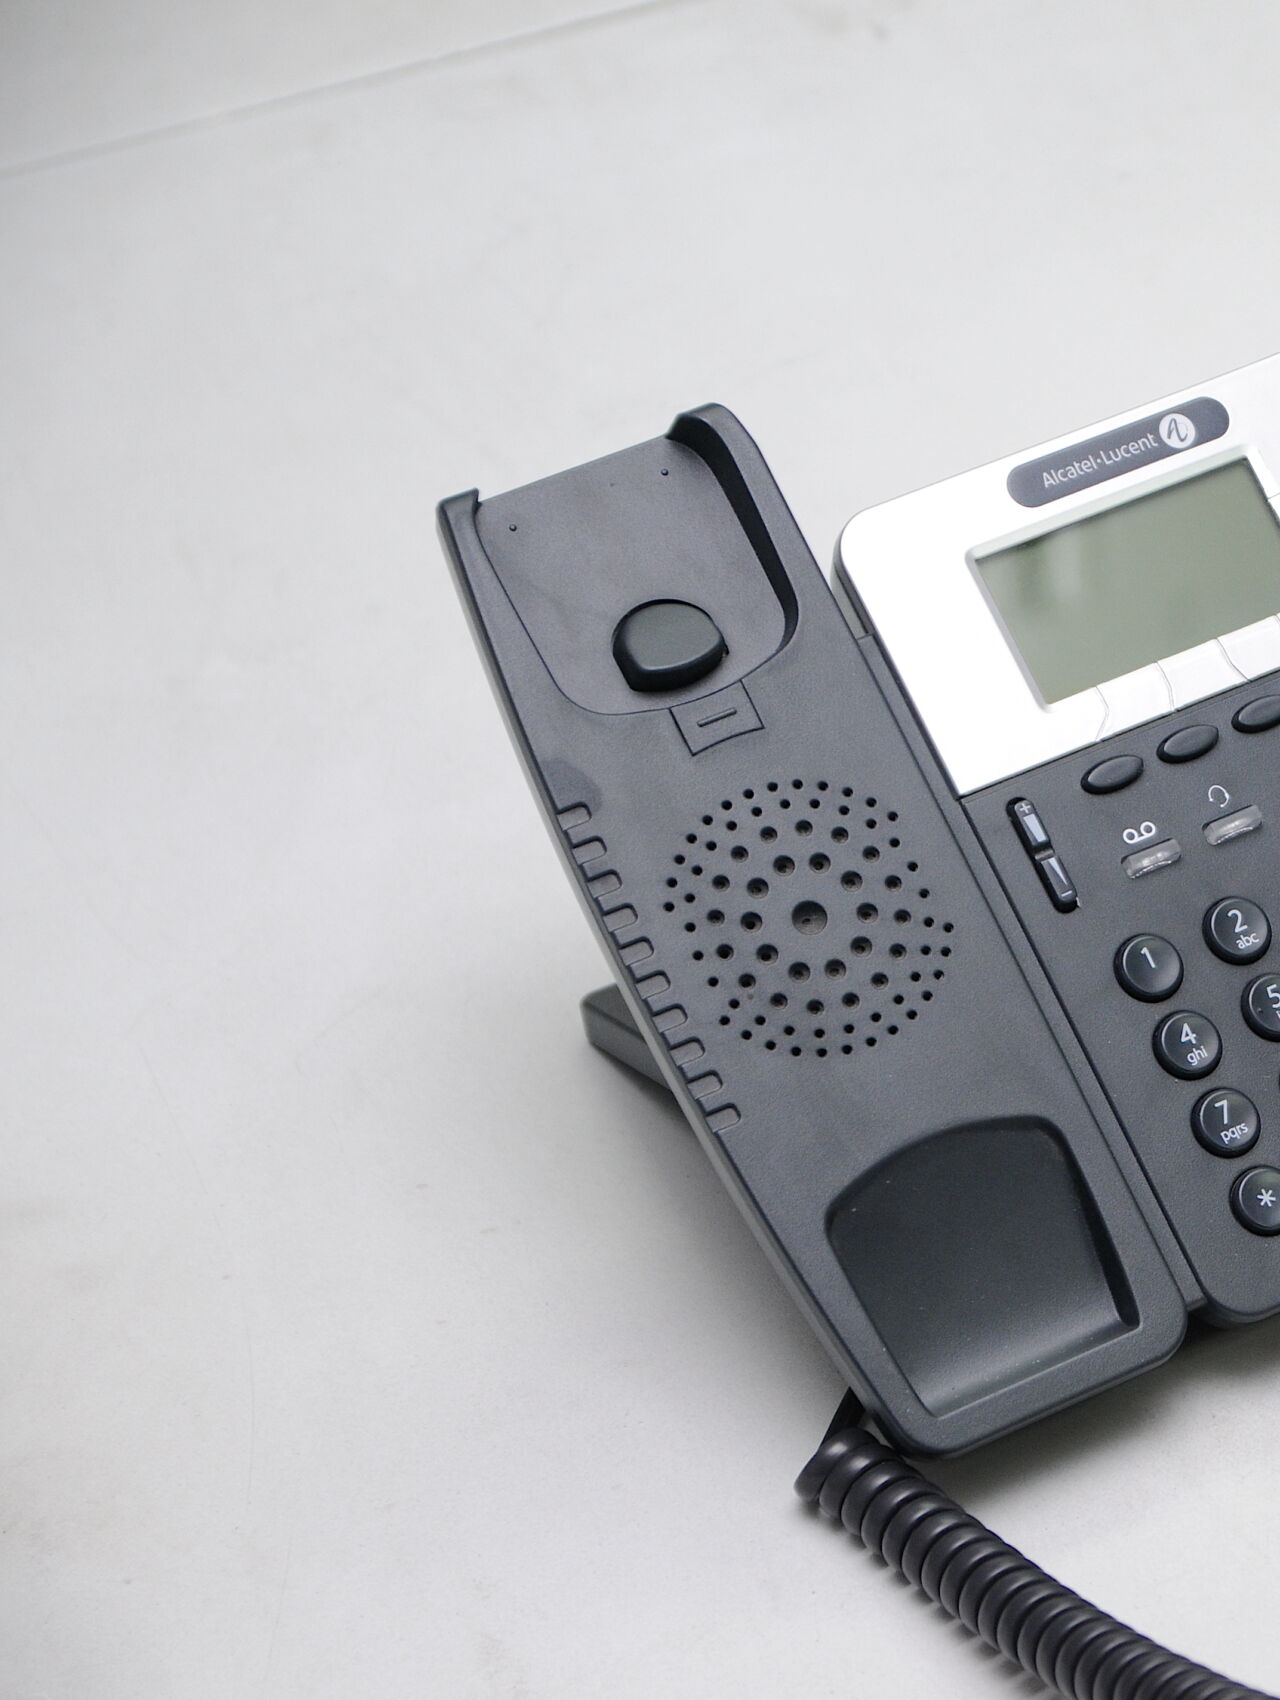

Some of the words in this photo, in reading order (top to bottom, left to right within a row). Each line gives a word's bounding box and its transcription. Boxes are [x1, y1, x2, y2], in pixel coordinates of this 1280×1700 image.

[1227, 909, 1248, 932] 2
[1236, 933, 1259, 949] abc
[1140, 946, 1156, 969] 1
[1180, 1023, 1198, 1045] 4
[1187, 1045, 1208, 1067] ghi
[1214, 1099, 1230, 1125] 7
[1220, 1122, 1249, 1145] pqrs
